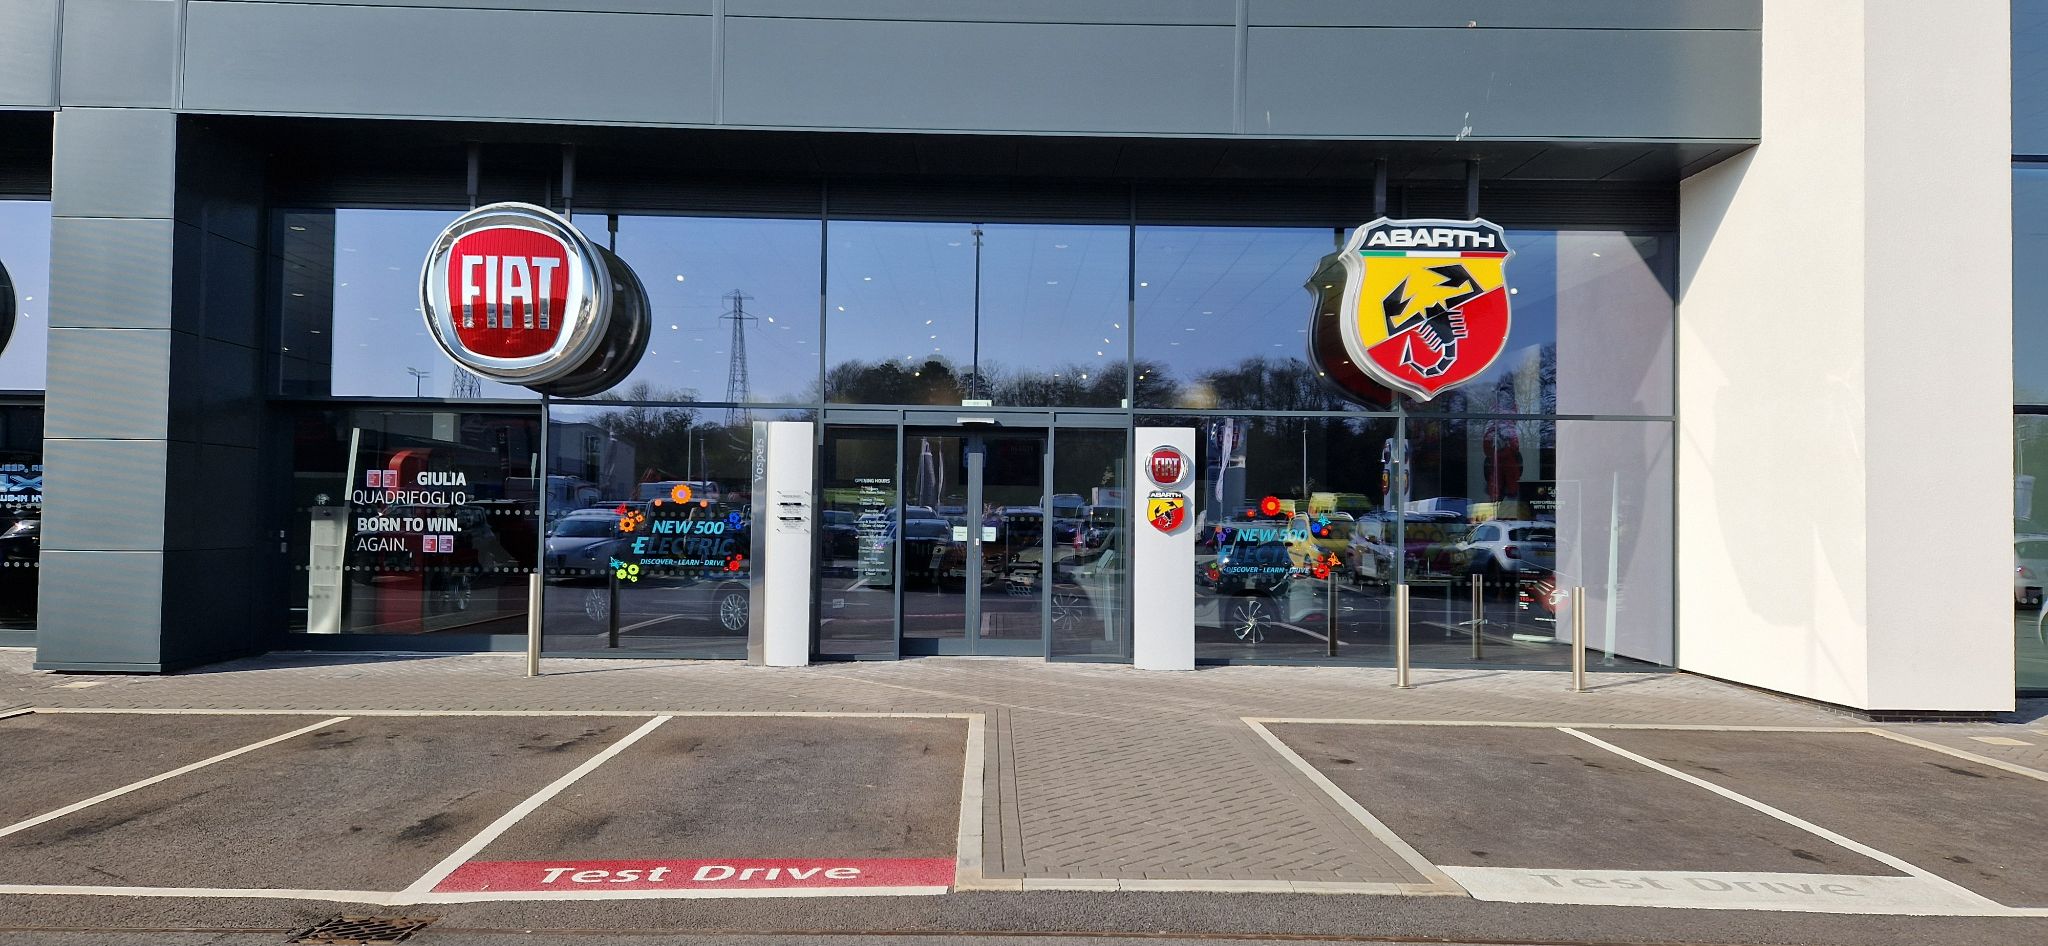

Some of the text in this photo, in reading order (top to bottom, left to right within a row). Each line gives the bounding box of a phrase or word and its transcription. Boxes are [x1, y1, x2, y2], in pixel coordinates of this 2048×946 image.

[1367, 228, 1495, 248] ABARTH
[461, 254, 561, 330] FIAT
[754, 438, 766, 483] Vospers
[1154, 457, 1179, 478] FIAT
[417, 471, 467, 486] GIULIA
[352, 489, 466, 505] QUADRIFOGLIO
[357, 517, 462, 532] BORN TO WIN.
[652, 519, 725, 535] NEW 500
[1236, 528, 1308, 542] NEW 500
[356, 537, 408, 552] AGAIN.
[704, 559, 725, 567] DRIVE
[540, 864, 862, 885] Test Drive
[1528, 872, 1868, 898] Test Drive
